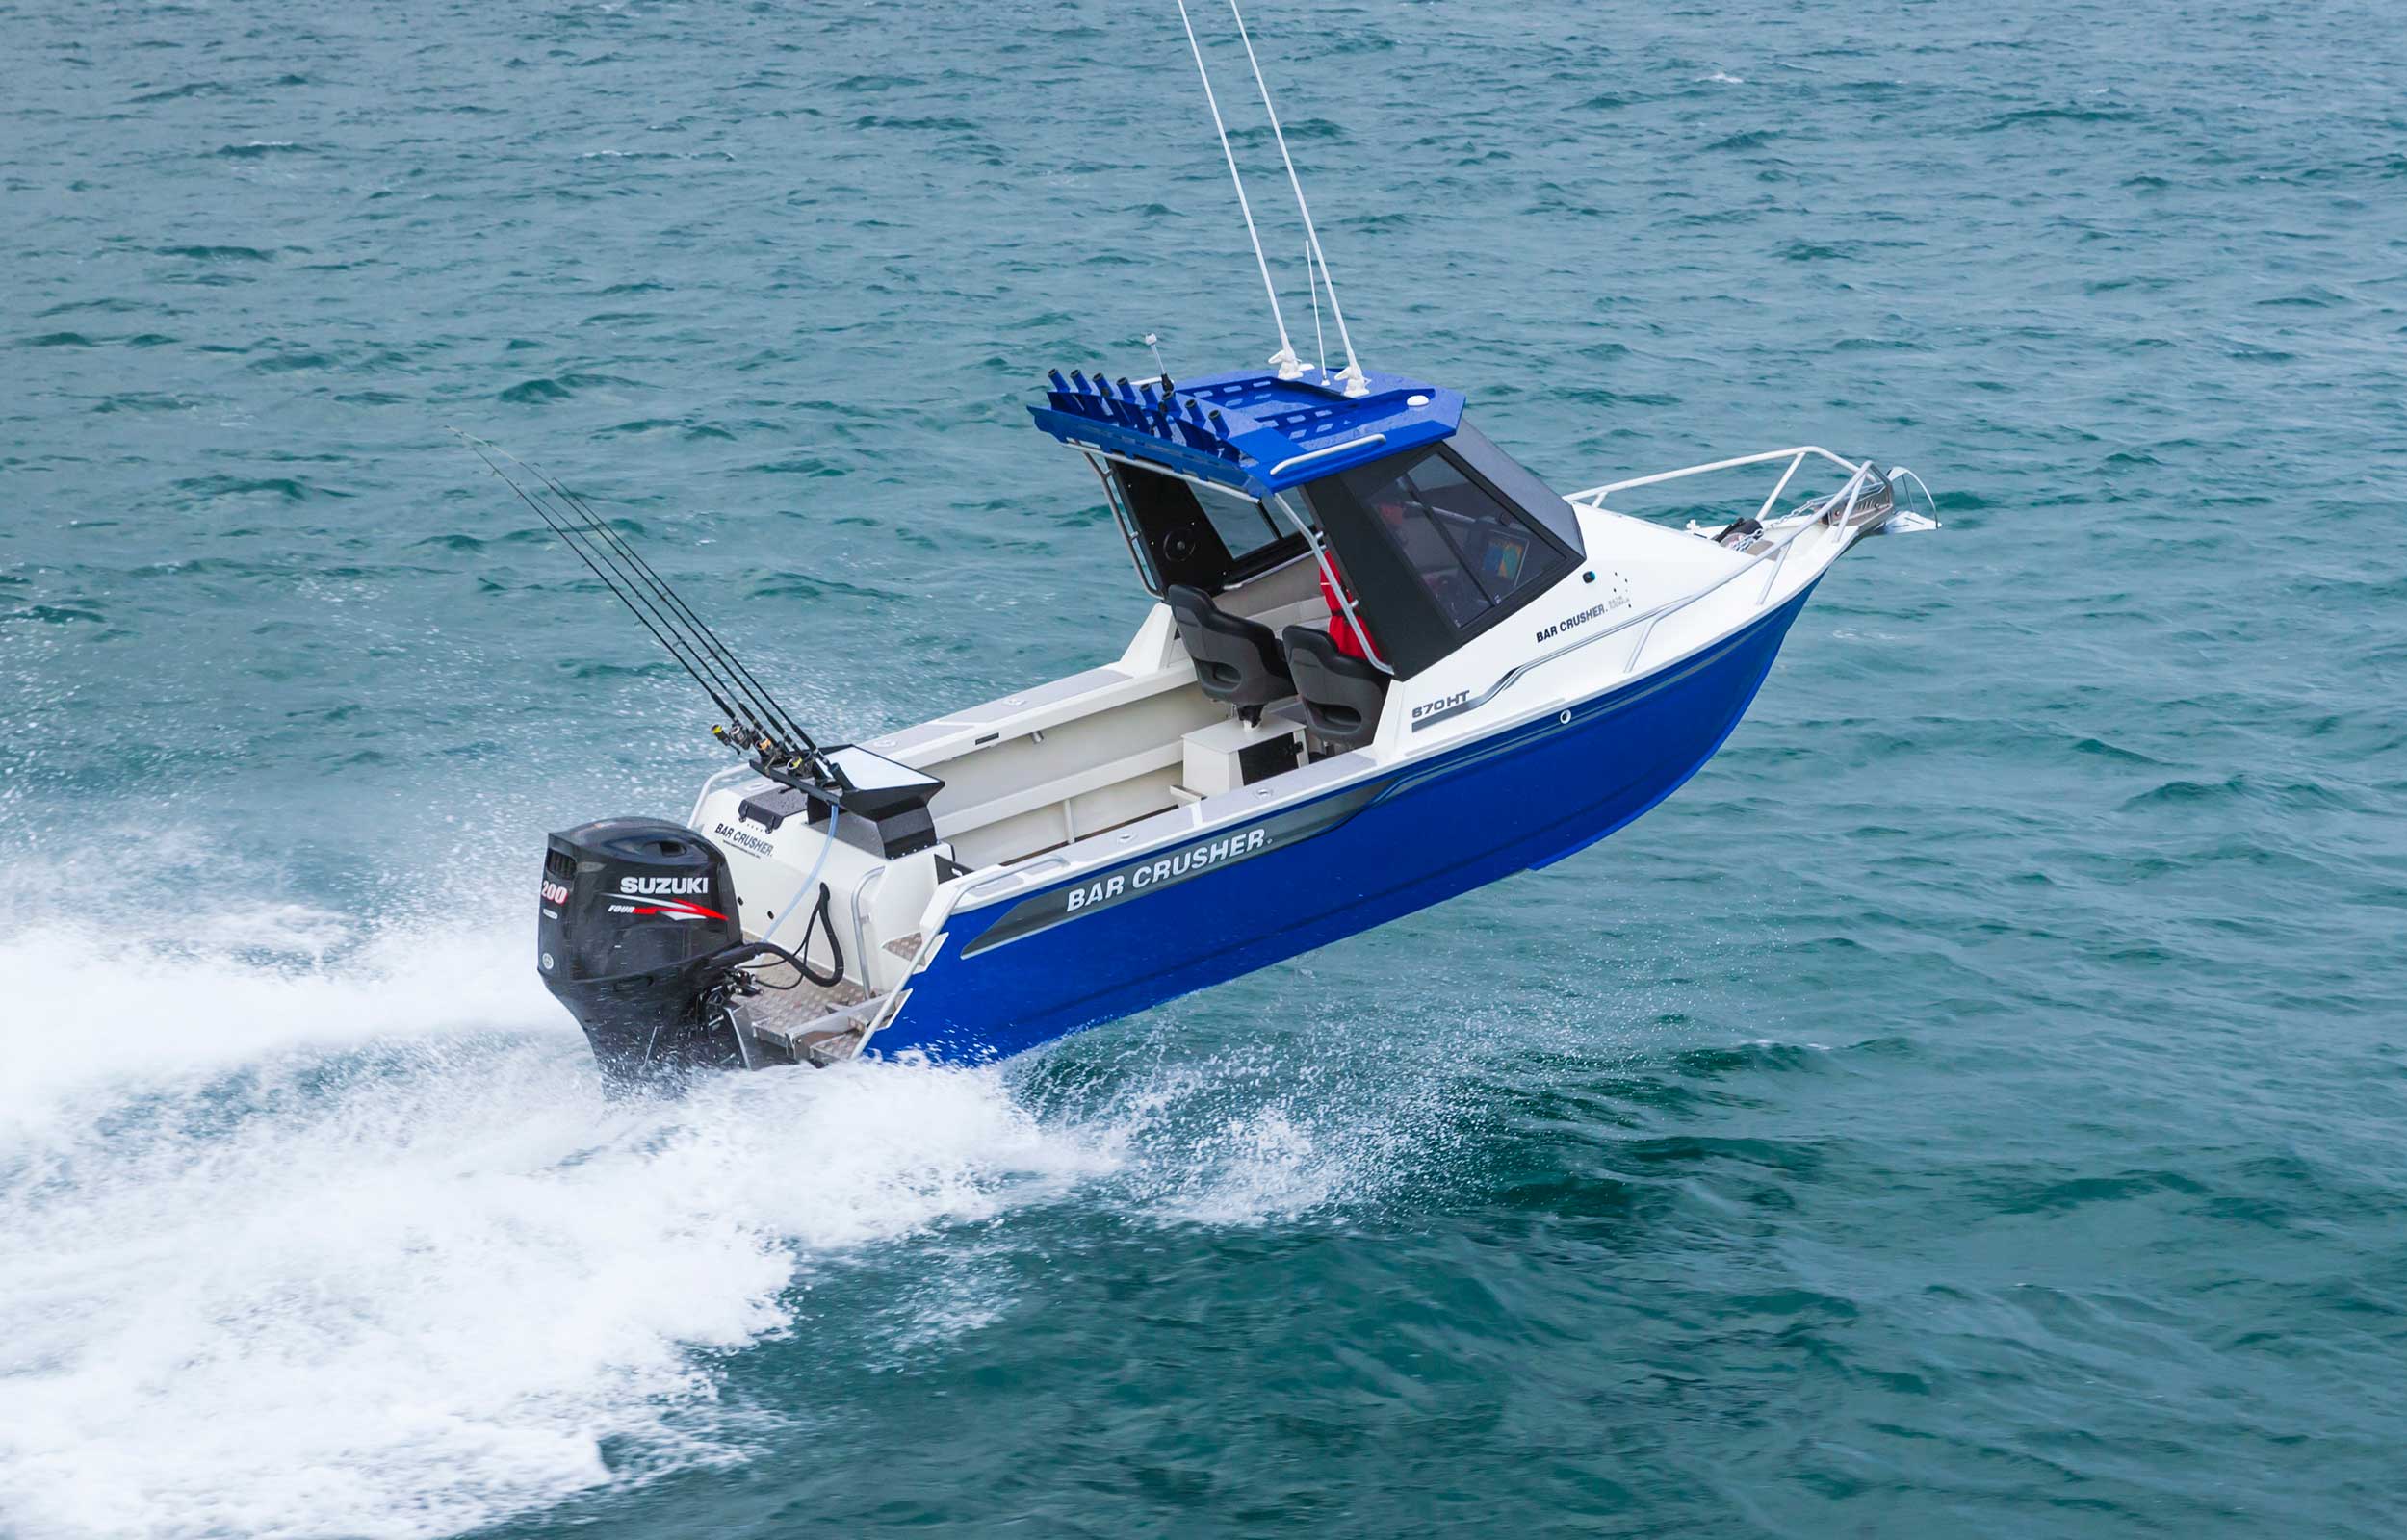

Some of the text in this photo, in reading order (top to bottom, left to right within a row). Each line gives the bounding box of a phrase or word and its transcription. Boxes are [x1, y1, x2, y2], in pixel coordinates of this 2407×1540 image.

[1536, 626, 1558, 643] BAR
[714, 823, 734, 838] BAR
[541, 880, 567, 905] 200
[620, 876, 709, 894] SUZUKI
[1067, 875, 1125, 911] BAR
[608, 904, 635, 913] FOUR
